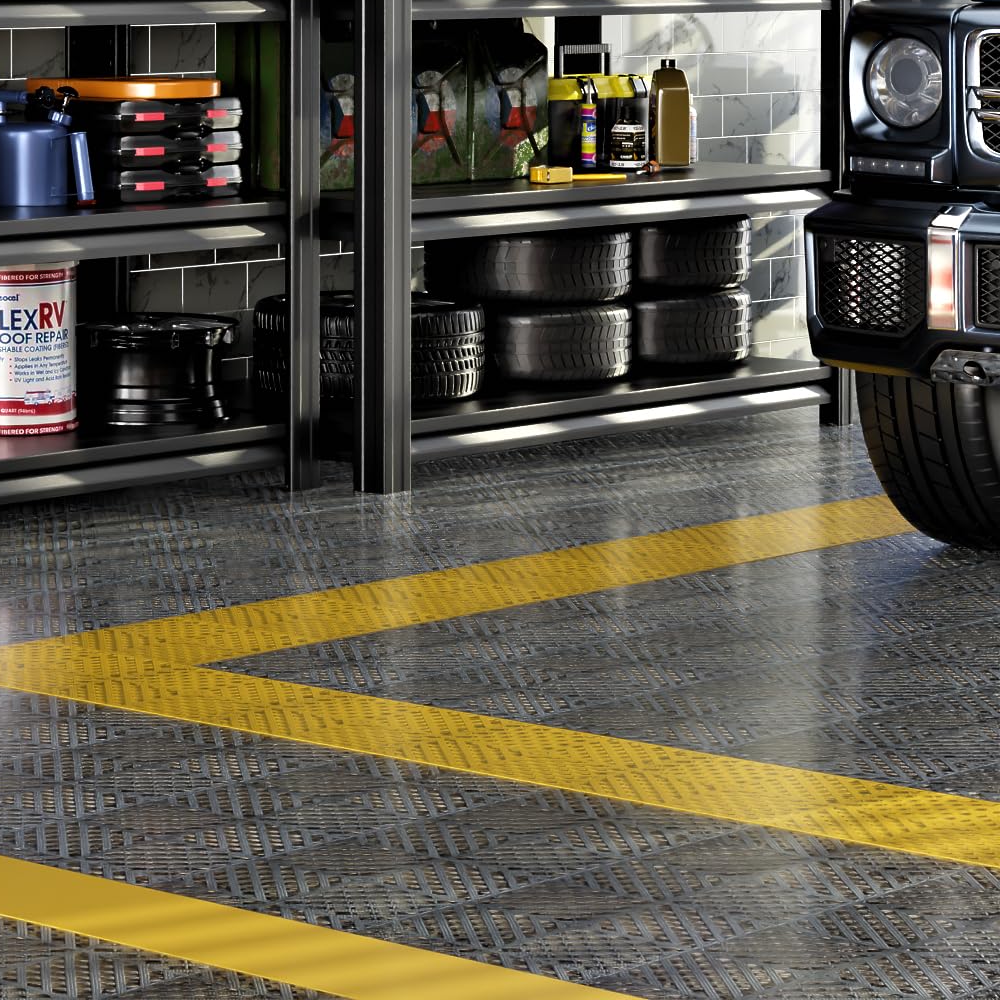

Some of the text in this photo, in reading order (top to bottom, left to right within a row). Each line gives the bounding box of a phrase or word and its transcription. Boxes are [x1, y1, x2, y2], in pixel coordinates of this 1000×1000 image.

[40, 272, 63, 280] STRENGTH
[36, 328, 69, 343] REPAIR
[24, 343, 52, 352] COATING
